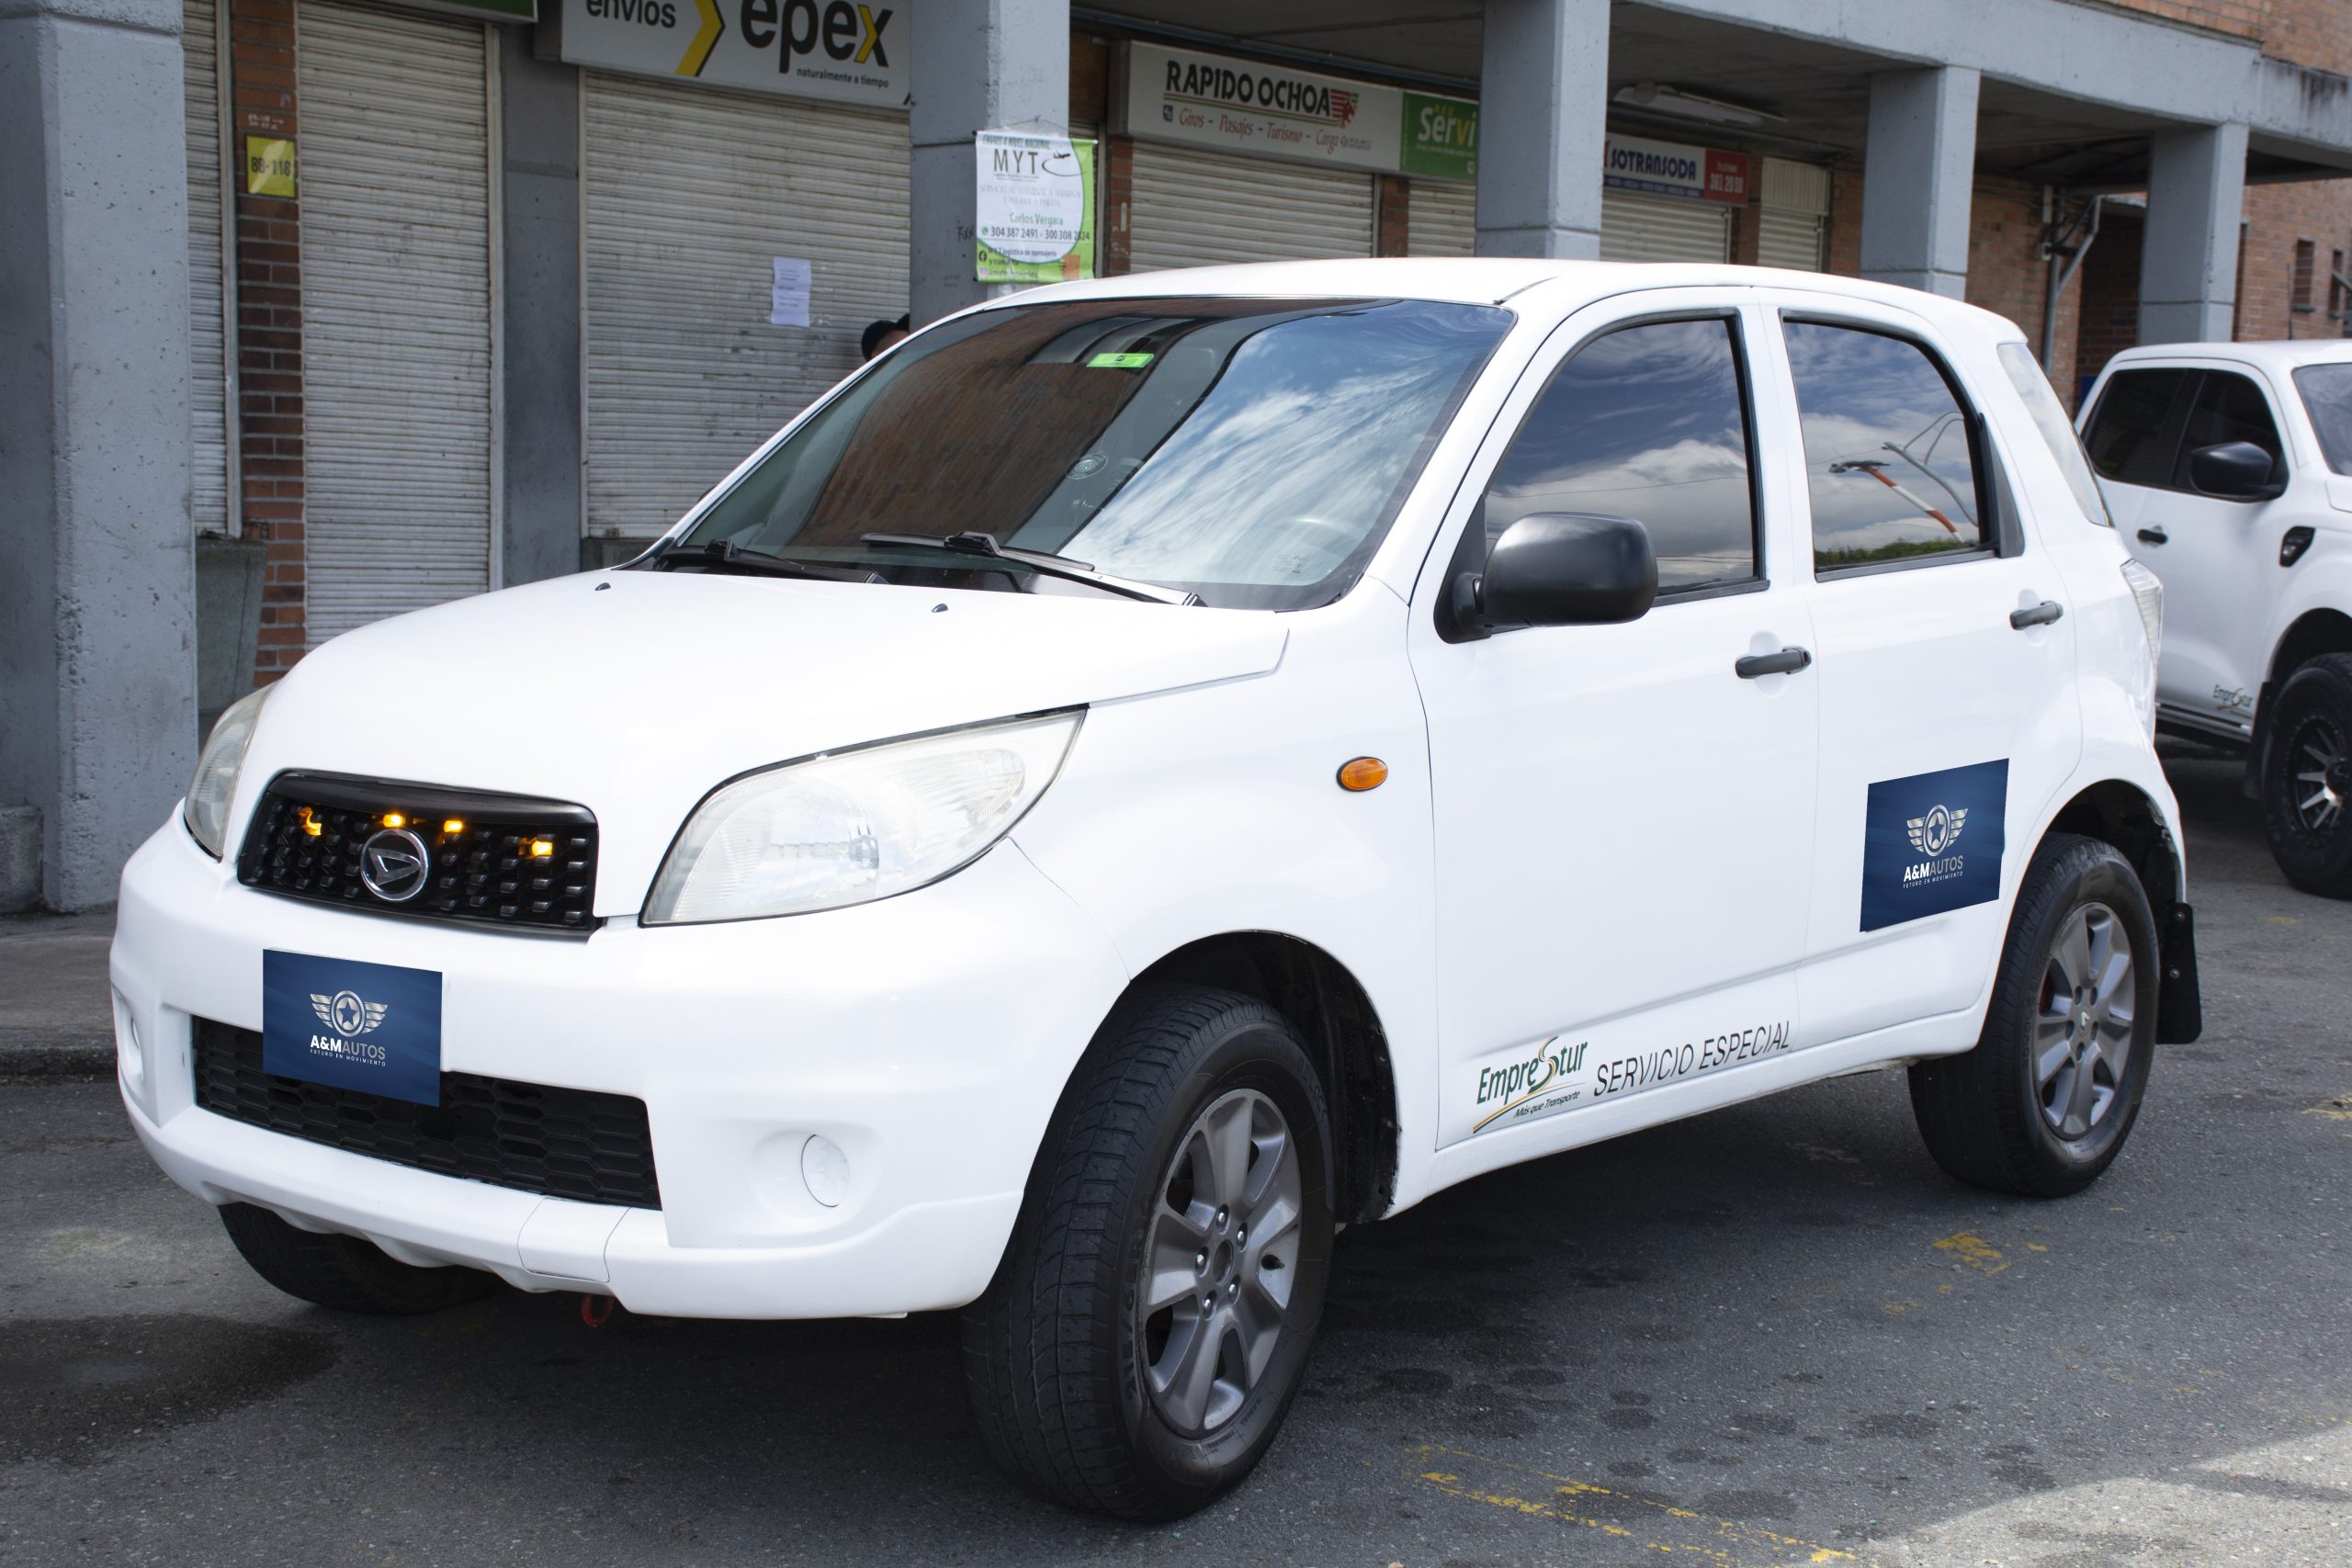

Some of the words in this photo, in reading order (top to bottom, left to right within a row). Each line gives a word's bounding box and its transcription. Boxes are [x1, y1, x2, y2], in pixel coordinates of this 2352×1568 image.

[741, 0, 893, 74] epex
[797, 67, 852, 84] naturalmente
[861, 74, 889, 89] tiempo
[1165, 60, 1253, 102] RAPIDO
[1258, 76, 1330, 118] OCHOA
[1179, 108, 1204, 128] Giros
[1219, 114, 1253, 141] Pasajes
[1267, 121, 1303, 143] Turismo
[1316, 129, 1339, 154] Carga
[1418, 107, 1477, 148] Servi
[1611, 148, 1697, 181] SOTRANSODA
[990, 227, 1004, 236] 304
[1007, 227, 1019, 237] 387
[1022, 228, 1038, 239] 2491
[1046, 230, 1057, 240] 300
[1059, 231, 1072, 241] 308
[1010, 212, 1034, 223] Carlos
[1035, 214, 1063, 227] Vergara
[1476, 1035, 1589, 1105] EmpreStur
[1594, 1043, 1694, 1097] SERVICIO
[1699, 1021, 1790, 1070] ESPECIAL
[1530, 1102, 1544, 1114] que
[1544, 1090, 1581, 1109] Transporte
